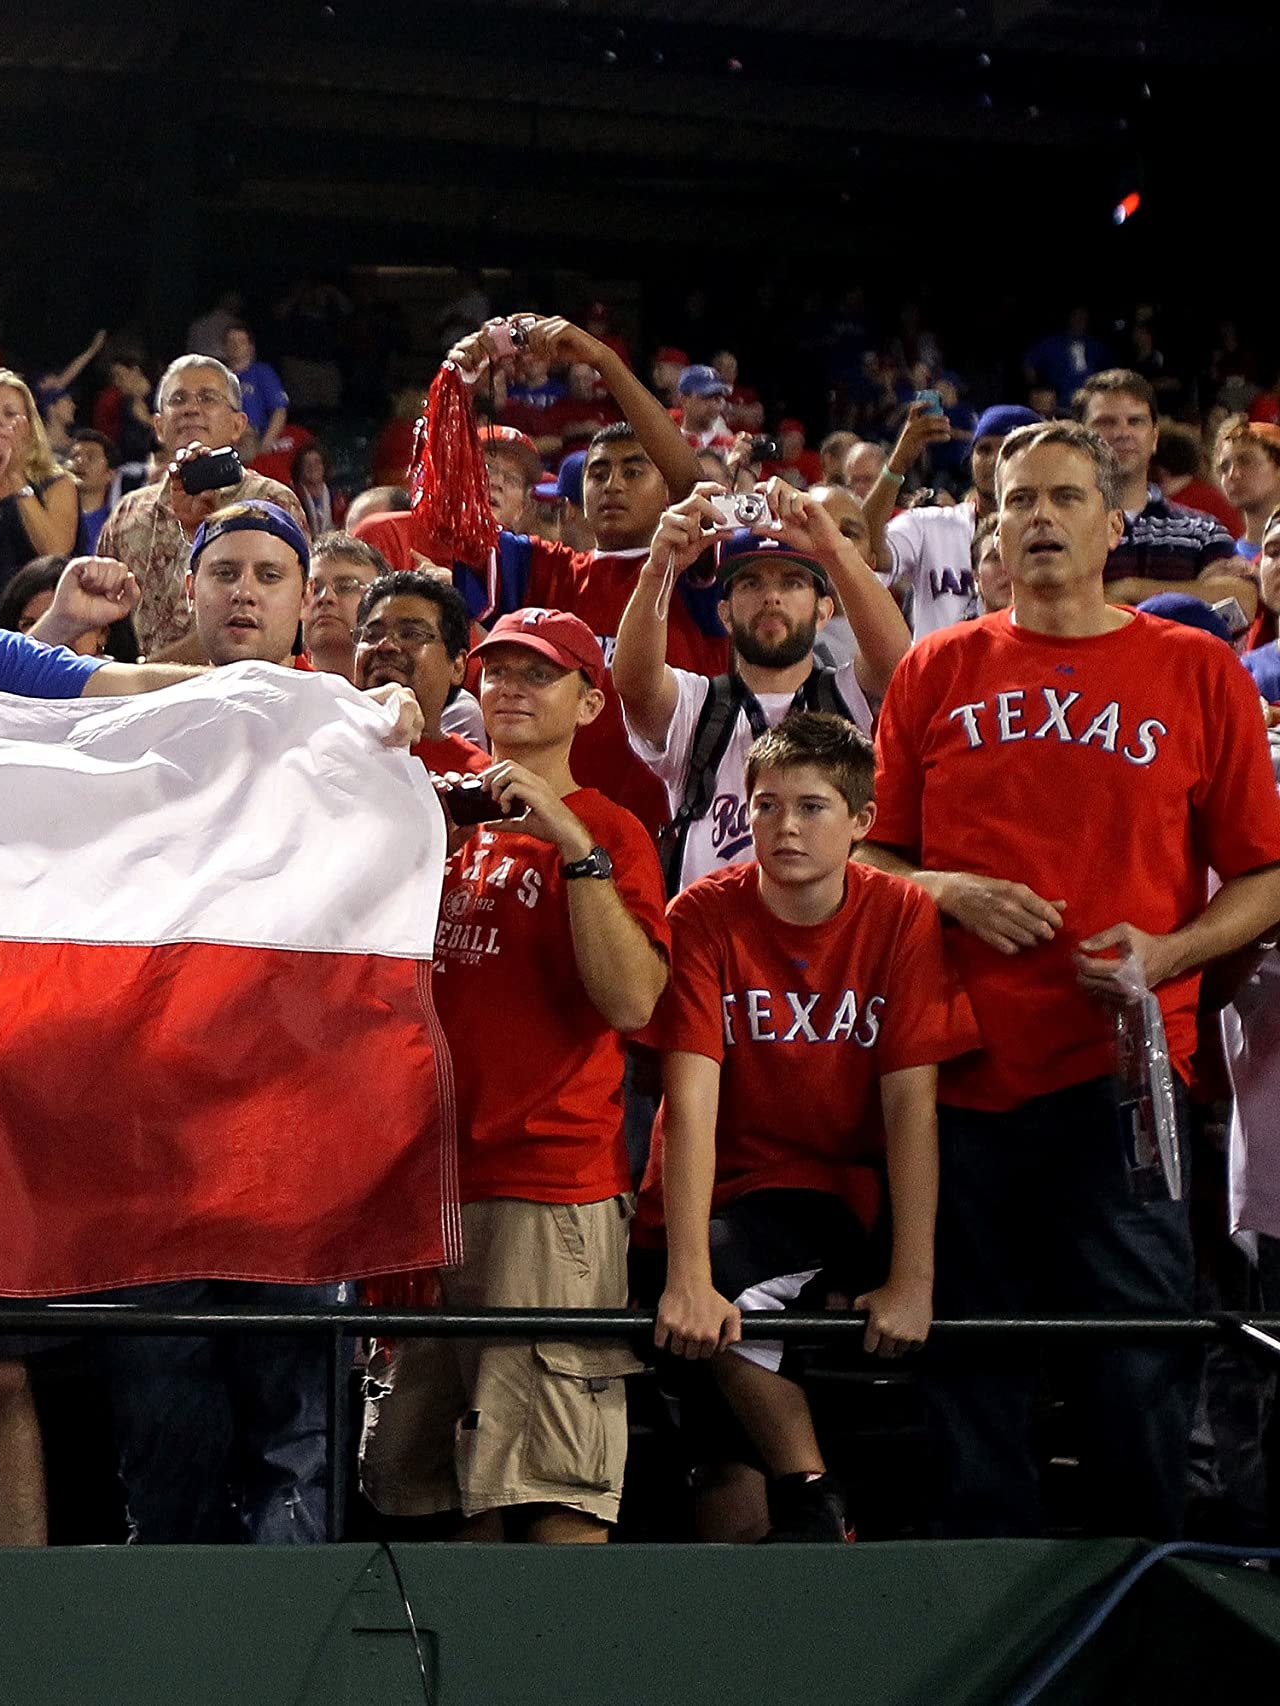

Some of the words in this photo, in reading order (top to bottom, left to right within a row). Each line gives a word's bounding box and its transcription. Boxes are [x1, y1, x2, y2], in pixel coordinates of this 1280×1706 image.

[523, 608, 550, 625] T
[948, 687, 1168, 767] TEXAS
[722, 988, 886, 1048] TEXAS
